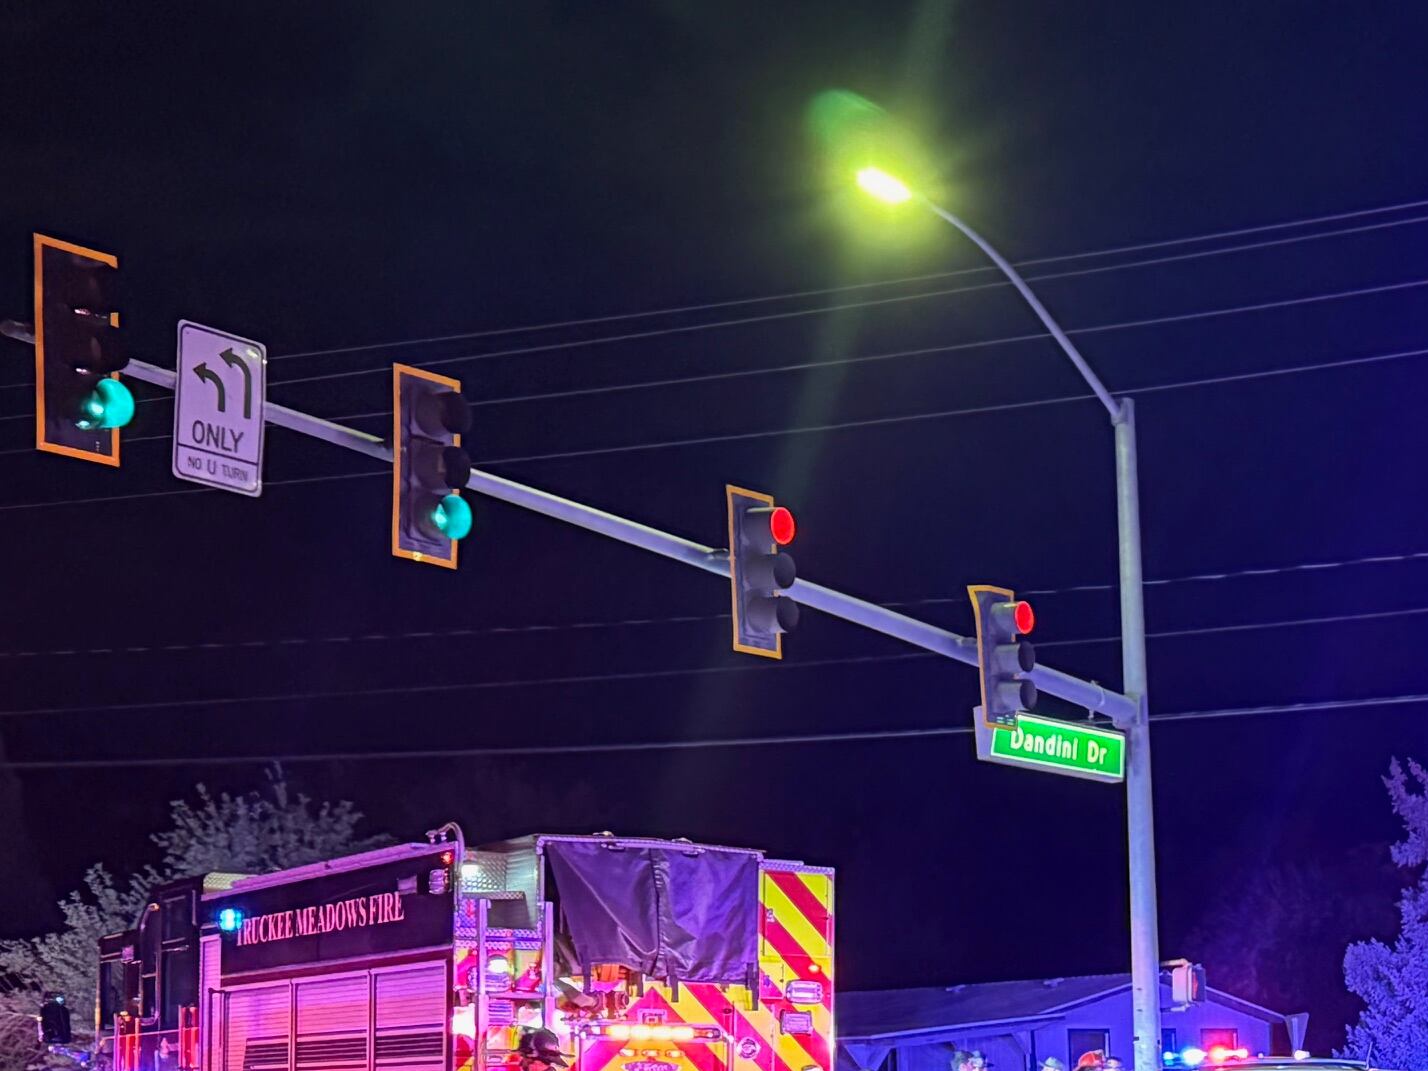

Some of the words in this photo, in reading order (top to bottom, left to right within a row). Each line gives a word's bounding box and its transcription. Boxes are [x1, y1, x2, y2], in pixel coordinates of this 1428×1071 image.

[192, 420, 244, 452] ONLY
[187, 456, 201, 470] NO
[207, 460, 217, 475] U
[222, 465, 248, 481] TURN
[1010, 727, 1079, 761] Dandini
[1087, 740, 1108, 765] Dr
[237, 910, 294, 947] TRUCKEE
[295, 896, 368, 936] MEADOWS
[368, 891, 405, 925] FIRE
